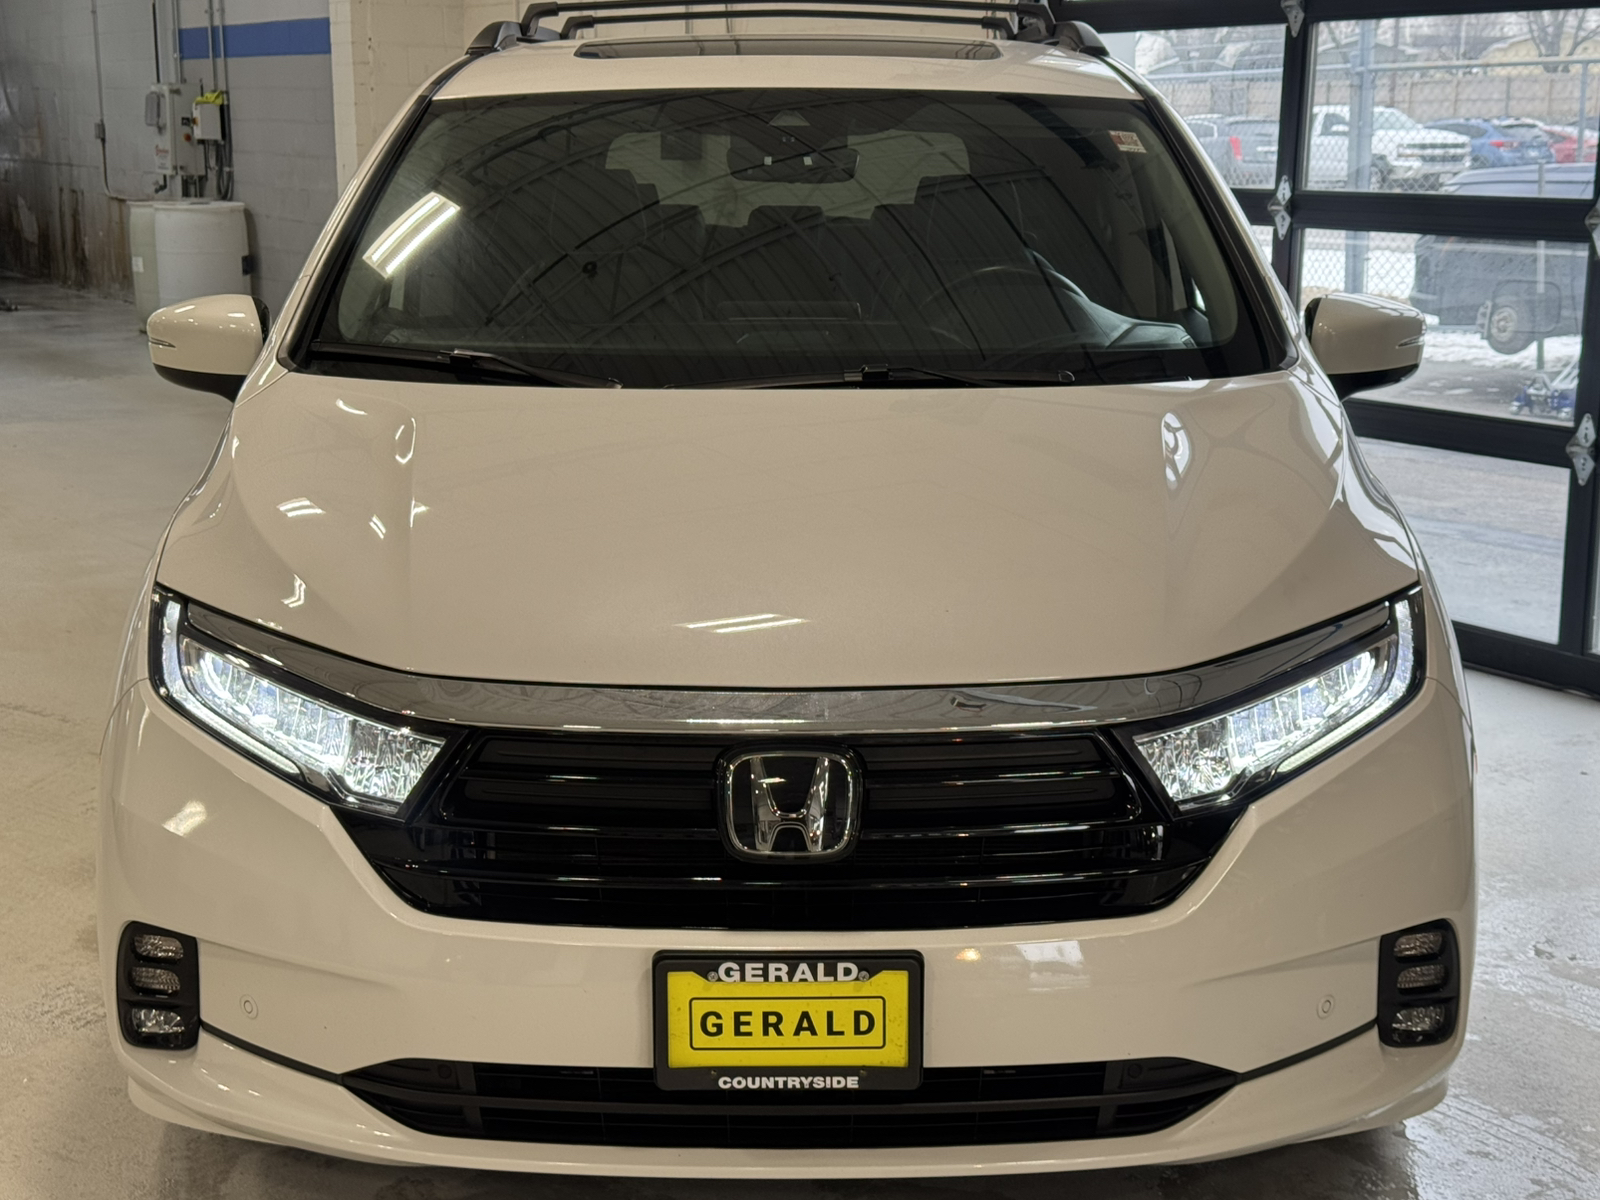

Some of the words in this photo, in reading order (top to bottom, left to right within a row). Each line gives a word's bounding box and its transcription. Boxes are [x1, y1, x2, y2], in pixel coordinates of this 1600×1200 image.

[718, 962, 859, 983] GERALD
[700, 1010, 876, 1037] GERALD
[718, 1076, 860, 1090] COUNTRYSIDE
